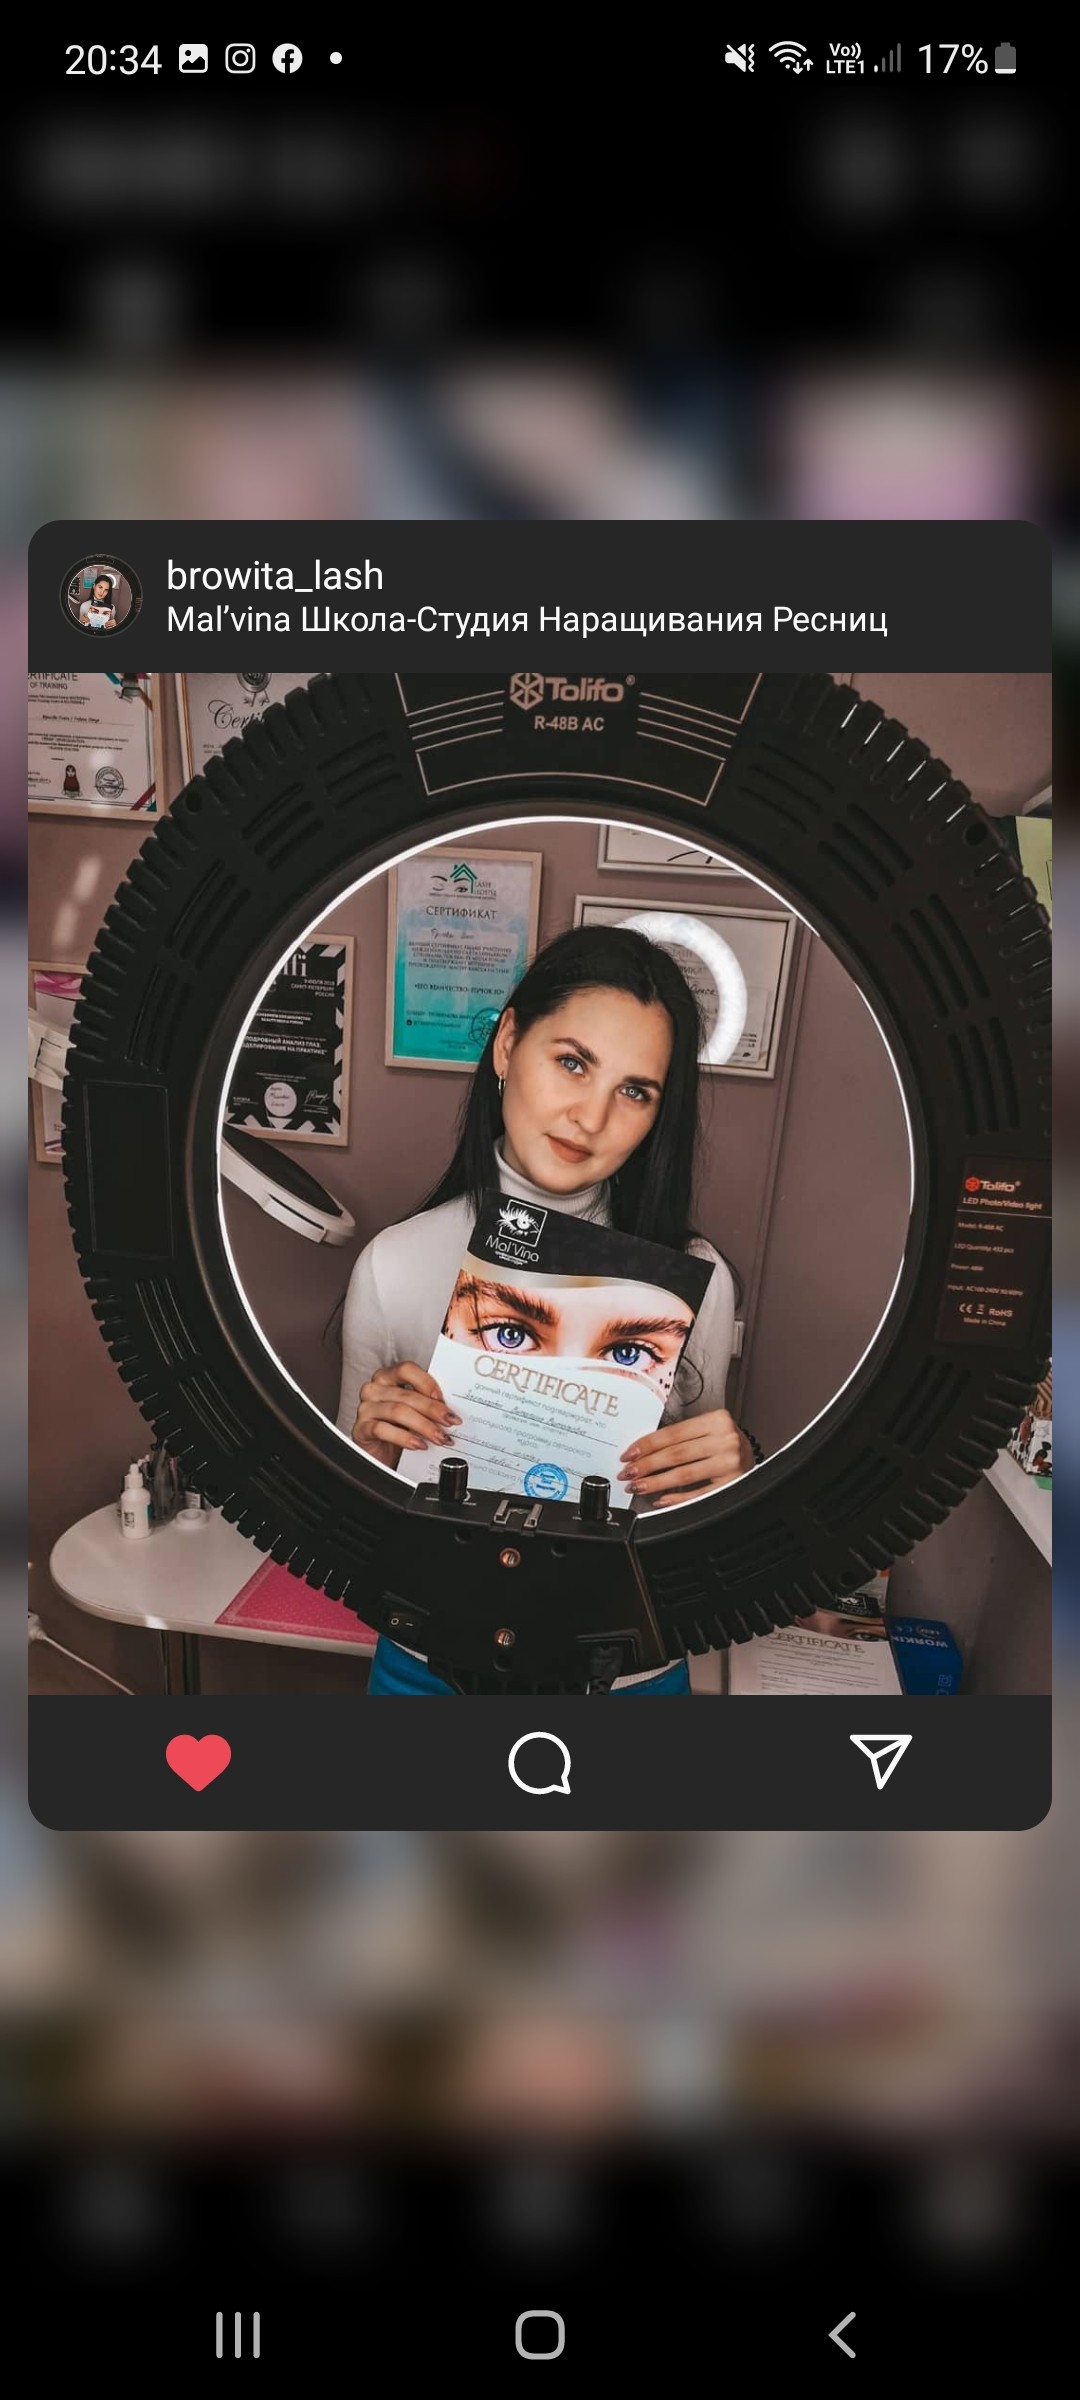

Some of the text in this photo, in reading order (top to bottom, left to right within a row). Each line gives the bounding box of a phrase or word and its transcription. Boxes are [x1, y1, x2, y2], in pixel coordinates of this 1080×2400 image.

[40, 682, 68, 690] TRAINING
[534, 715, 604, 731] R-48B AC
[426, 905, 498, 919] СЕРТИФИКАТ
[962, 1197, 1042, 1211] LED Photo/Video light
[989, 1308, 1013, 1318] RoHS
[474, 1354, 620, 1417] CERTIFICATE
